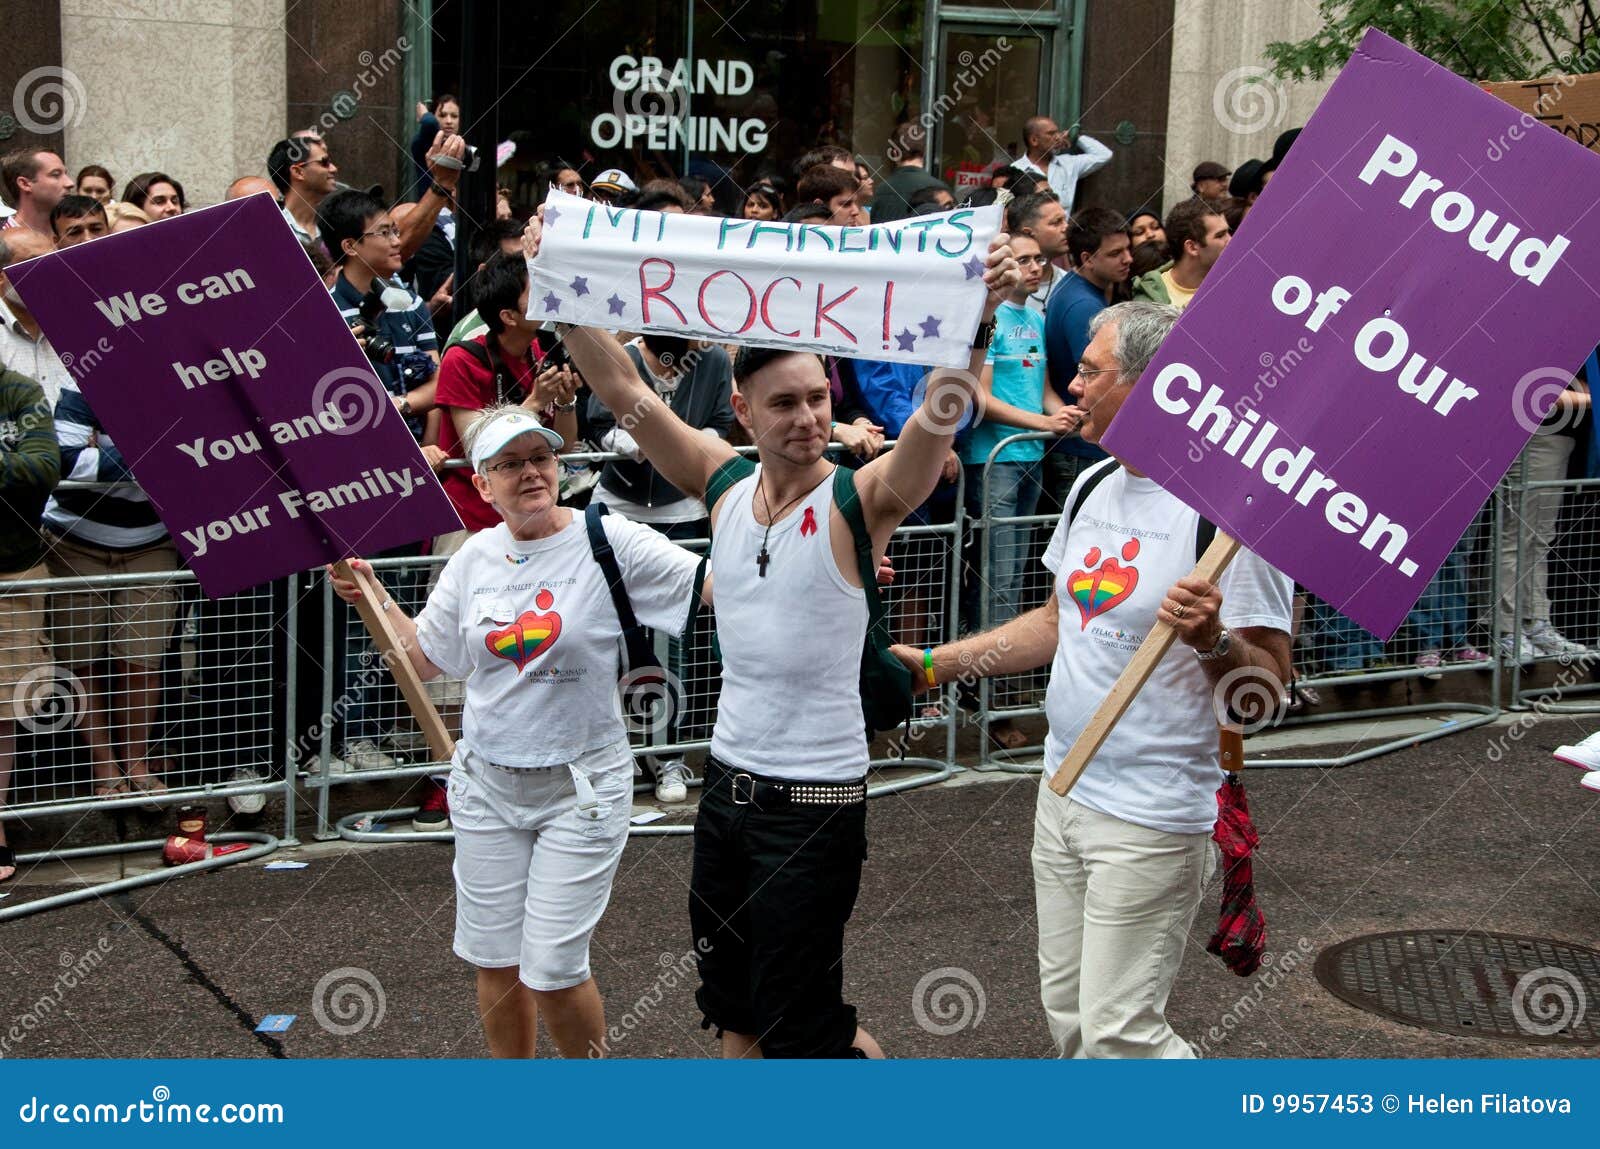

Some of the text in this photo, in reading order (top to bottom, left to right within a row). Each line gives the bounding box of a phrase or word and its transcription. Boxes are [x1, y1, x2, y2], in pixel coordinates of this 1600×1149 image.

[608, 55, 754, 95] GRAND
[590, 112, 768, 153] OPENING
[1358, 134, 1571, 287] Proud
[94, 268, 256, 327] We can
[638, 257, 896, 351] ROCK!
[172, 347, 267, 390] help
[1271, 275, 1480, 417] of Our
[175, 401, 347, 468] You and
[1152, 362, 1419, 578] Children.
[181, 467, 427, 557] your Family.
